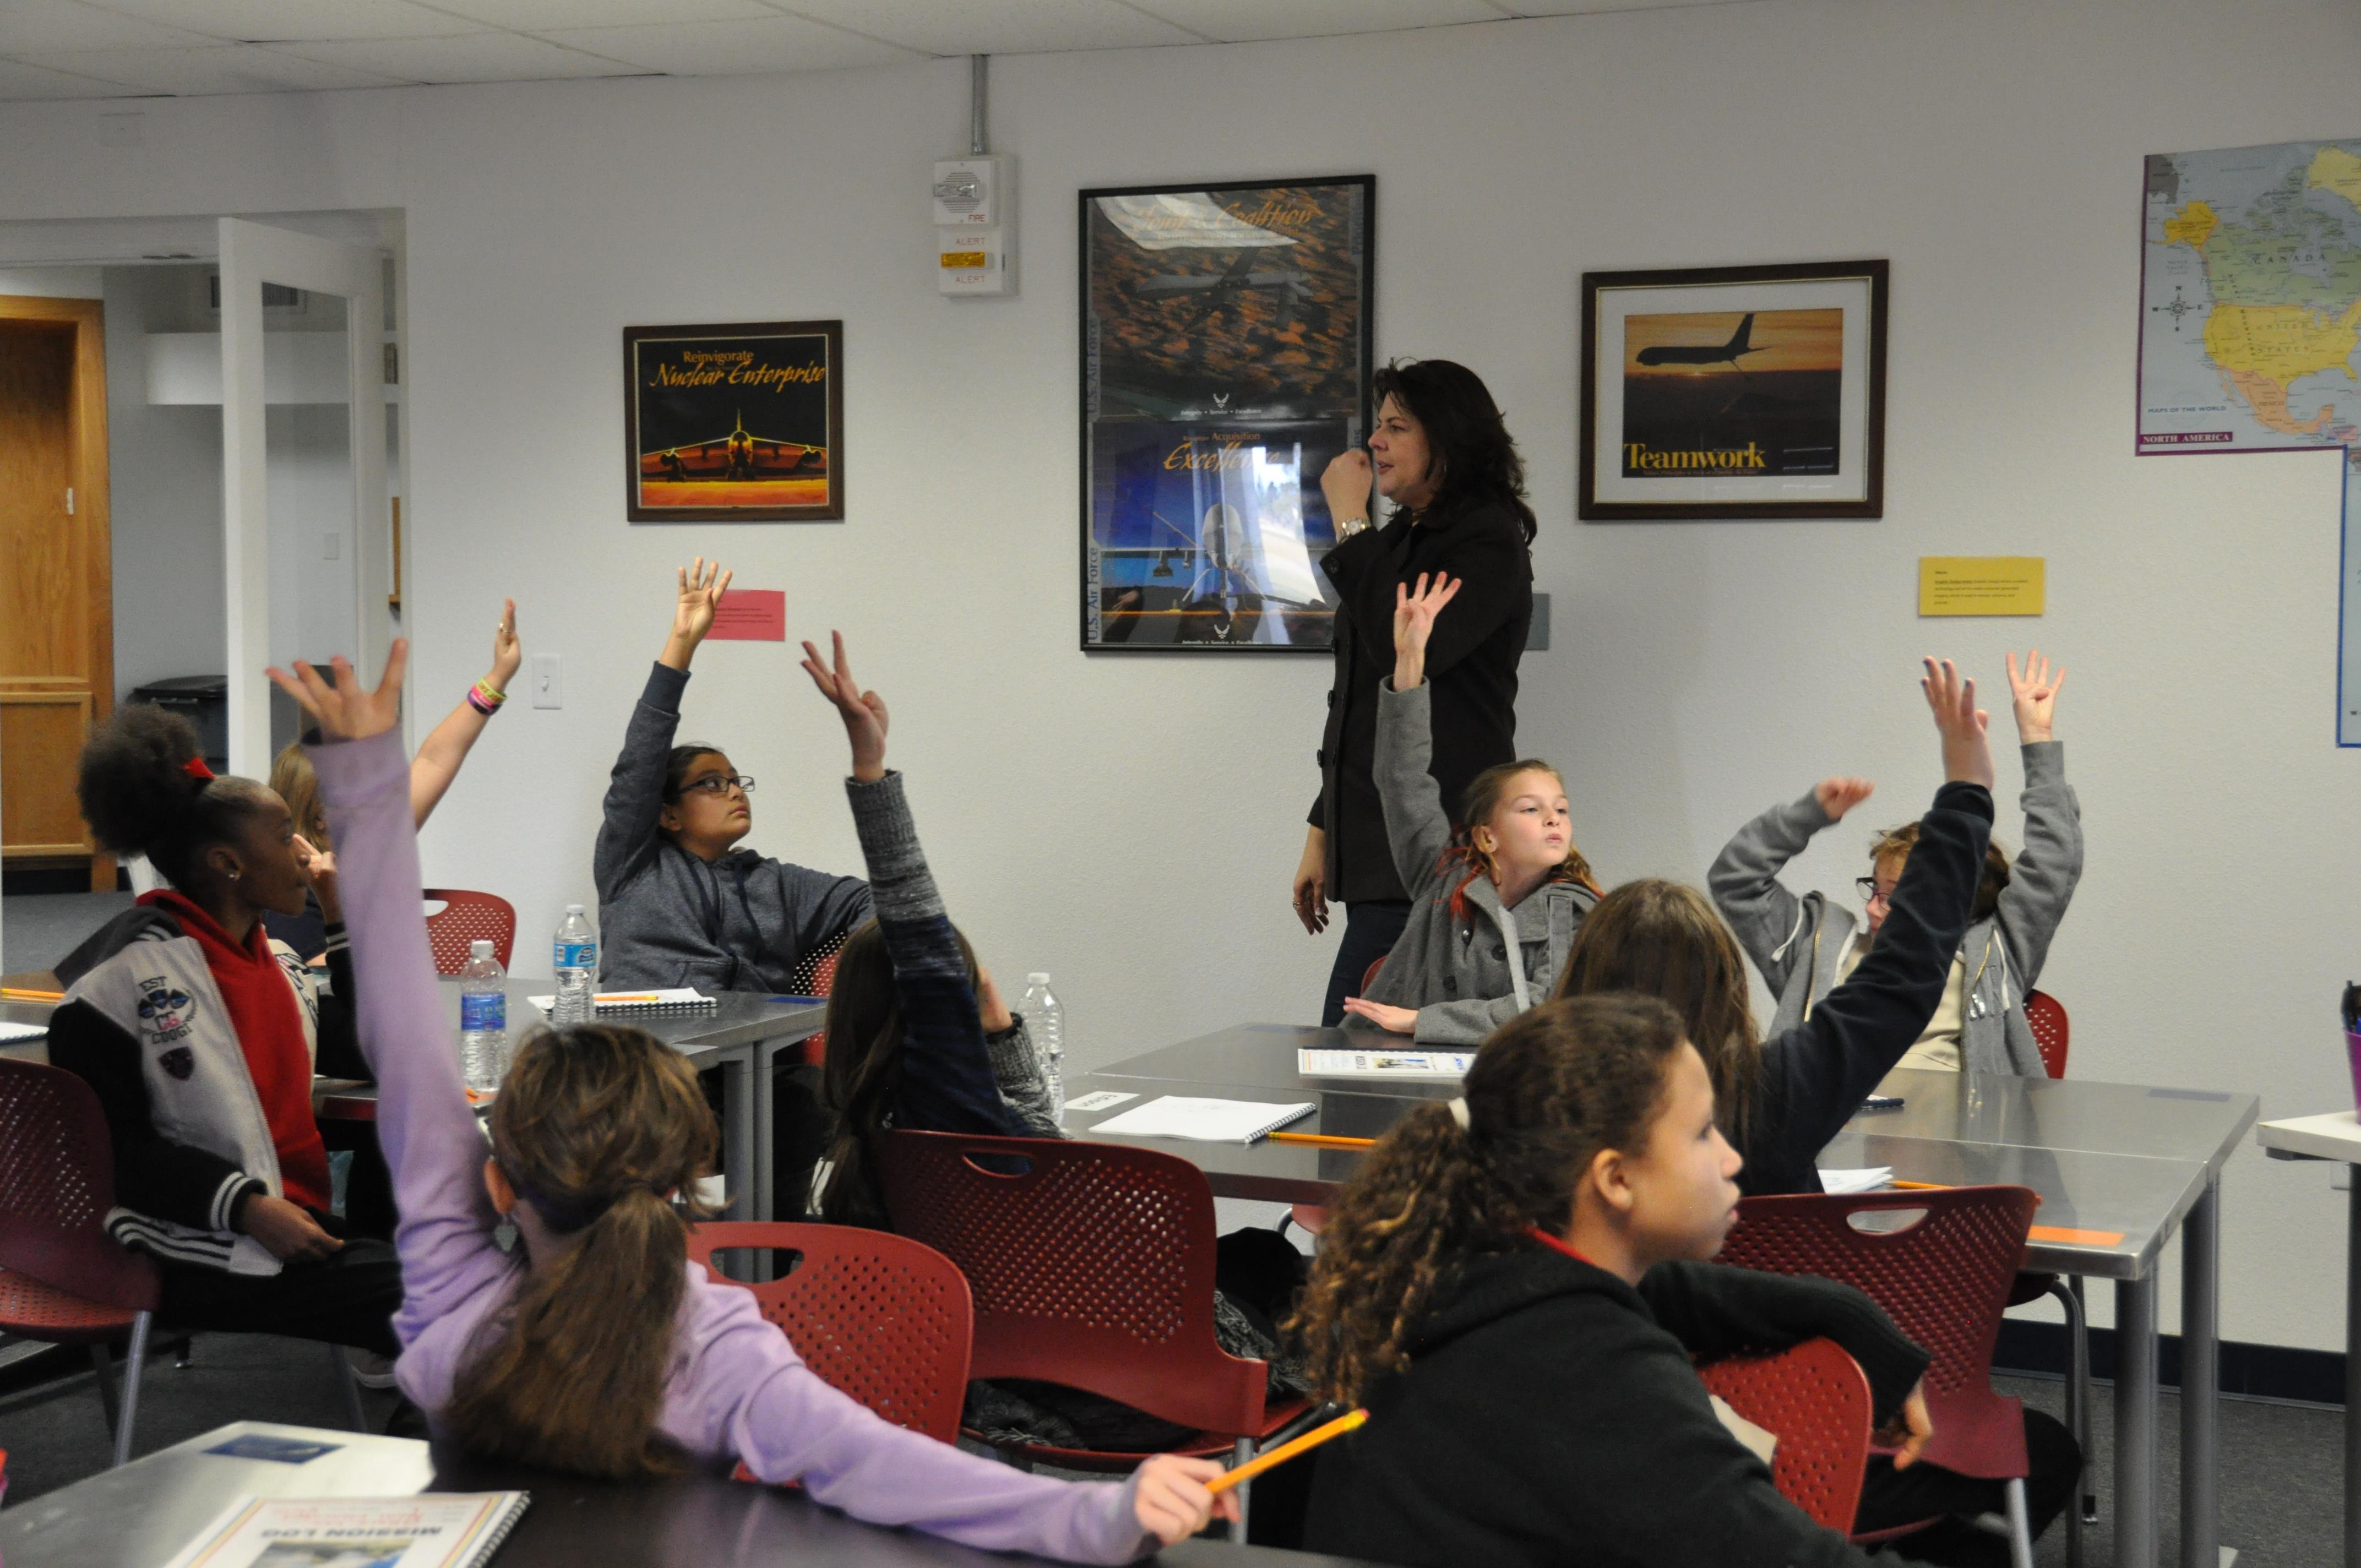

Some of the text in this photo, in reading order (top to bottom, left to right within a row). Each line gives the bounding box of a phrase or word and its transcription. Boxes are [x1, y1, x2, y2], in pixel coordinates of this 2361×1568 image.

[2254, 254, 2325, 264] CANADA
[955, 275, 987, 284] ALERT
[683, 350, 754, 365] Reinvigorate
[649, 359, 825, 393] Nuclear Enterprise
[1212, 431, 1261, 442] Acquisition
[2182, 433, 2229, 442] AMERICA
[1624, 442, 1766, 469] Teamwork
[1088, 547, 1098, 640] U.S. Air Force
[139, 976, 167, 992] EST
[151, 1023, 193, 1044] COOGI
